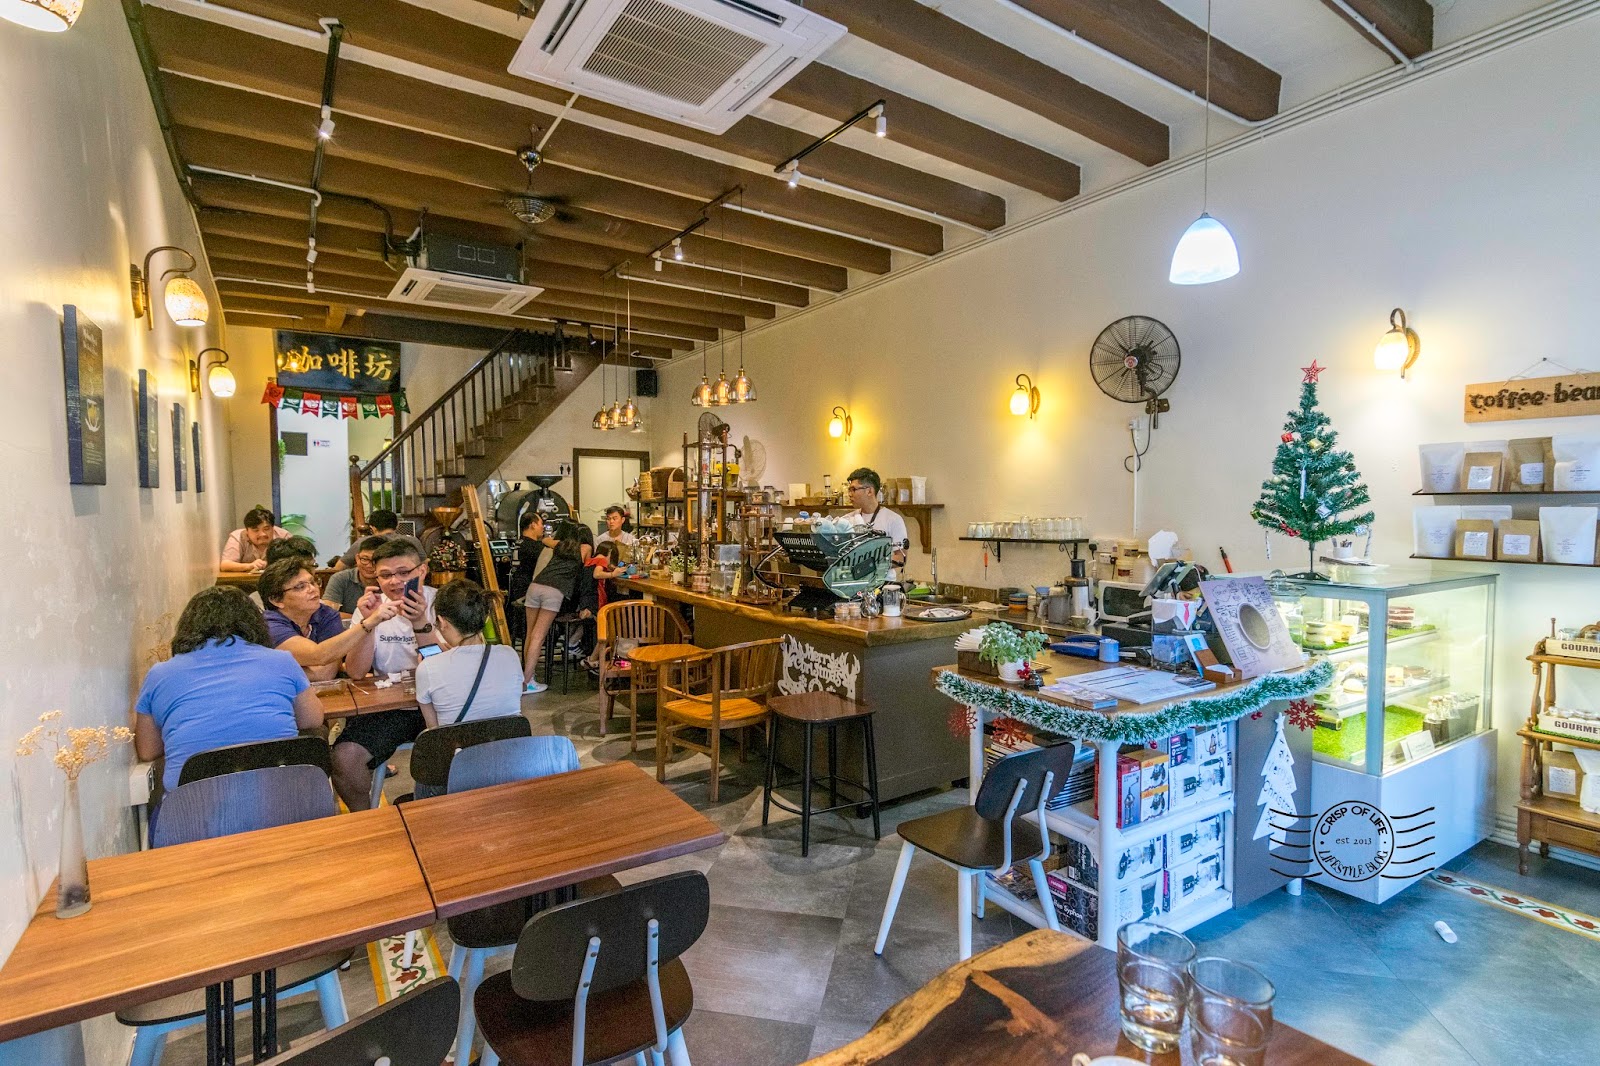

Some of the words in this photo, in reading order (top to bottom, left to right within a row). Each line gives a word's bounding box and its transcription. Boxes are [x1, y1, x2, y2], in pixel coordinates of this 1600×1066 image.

[1469, 388, 1545, 409] coffee
[1554, 382, 1600, 403] bea
[1561, 643, 1600, 654] GOURM
[1554, 720, 1600, 734] GOURME
[1064, 904, 1083, 920] Syphon
